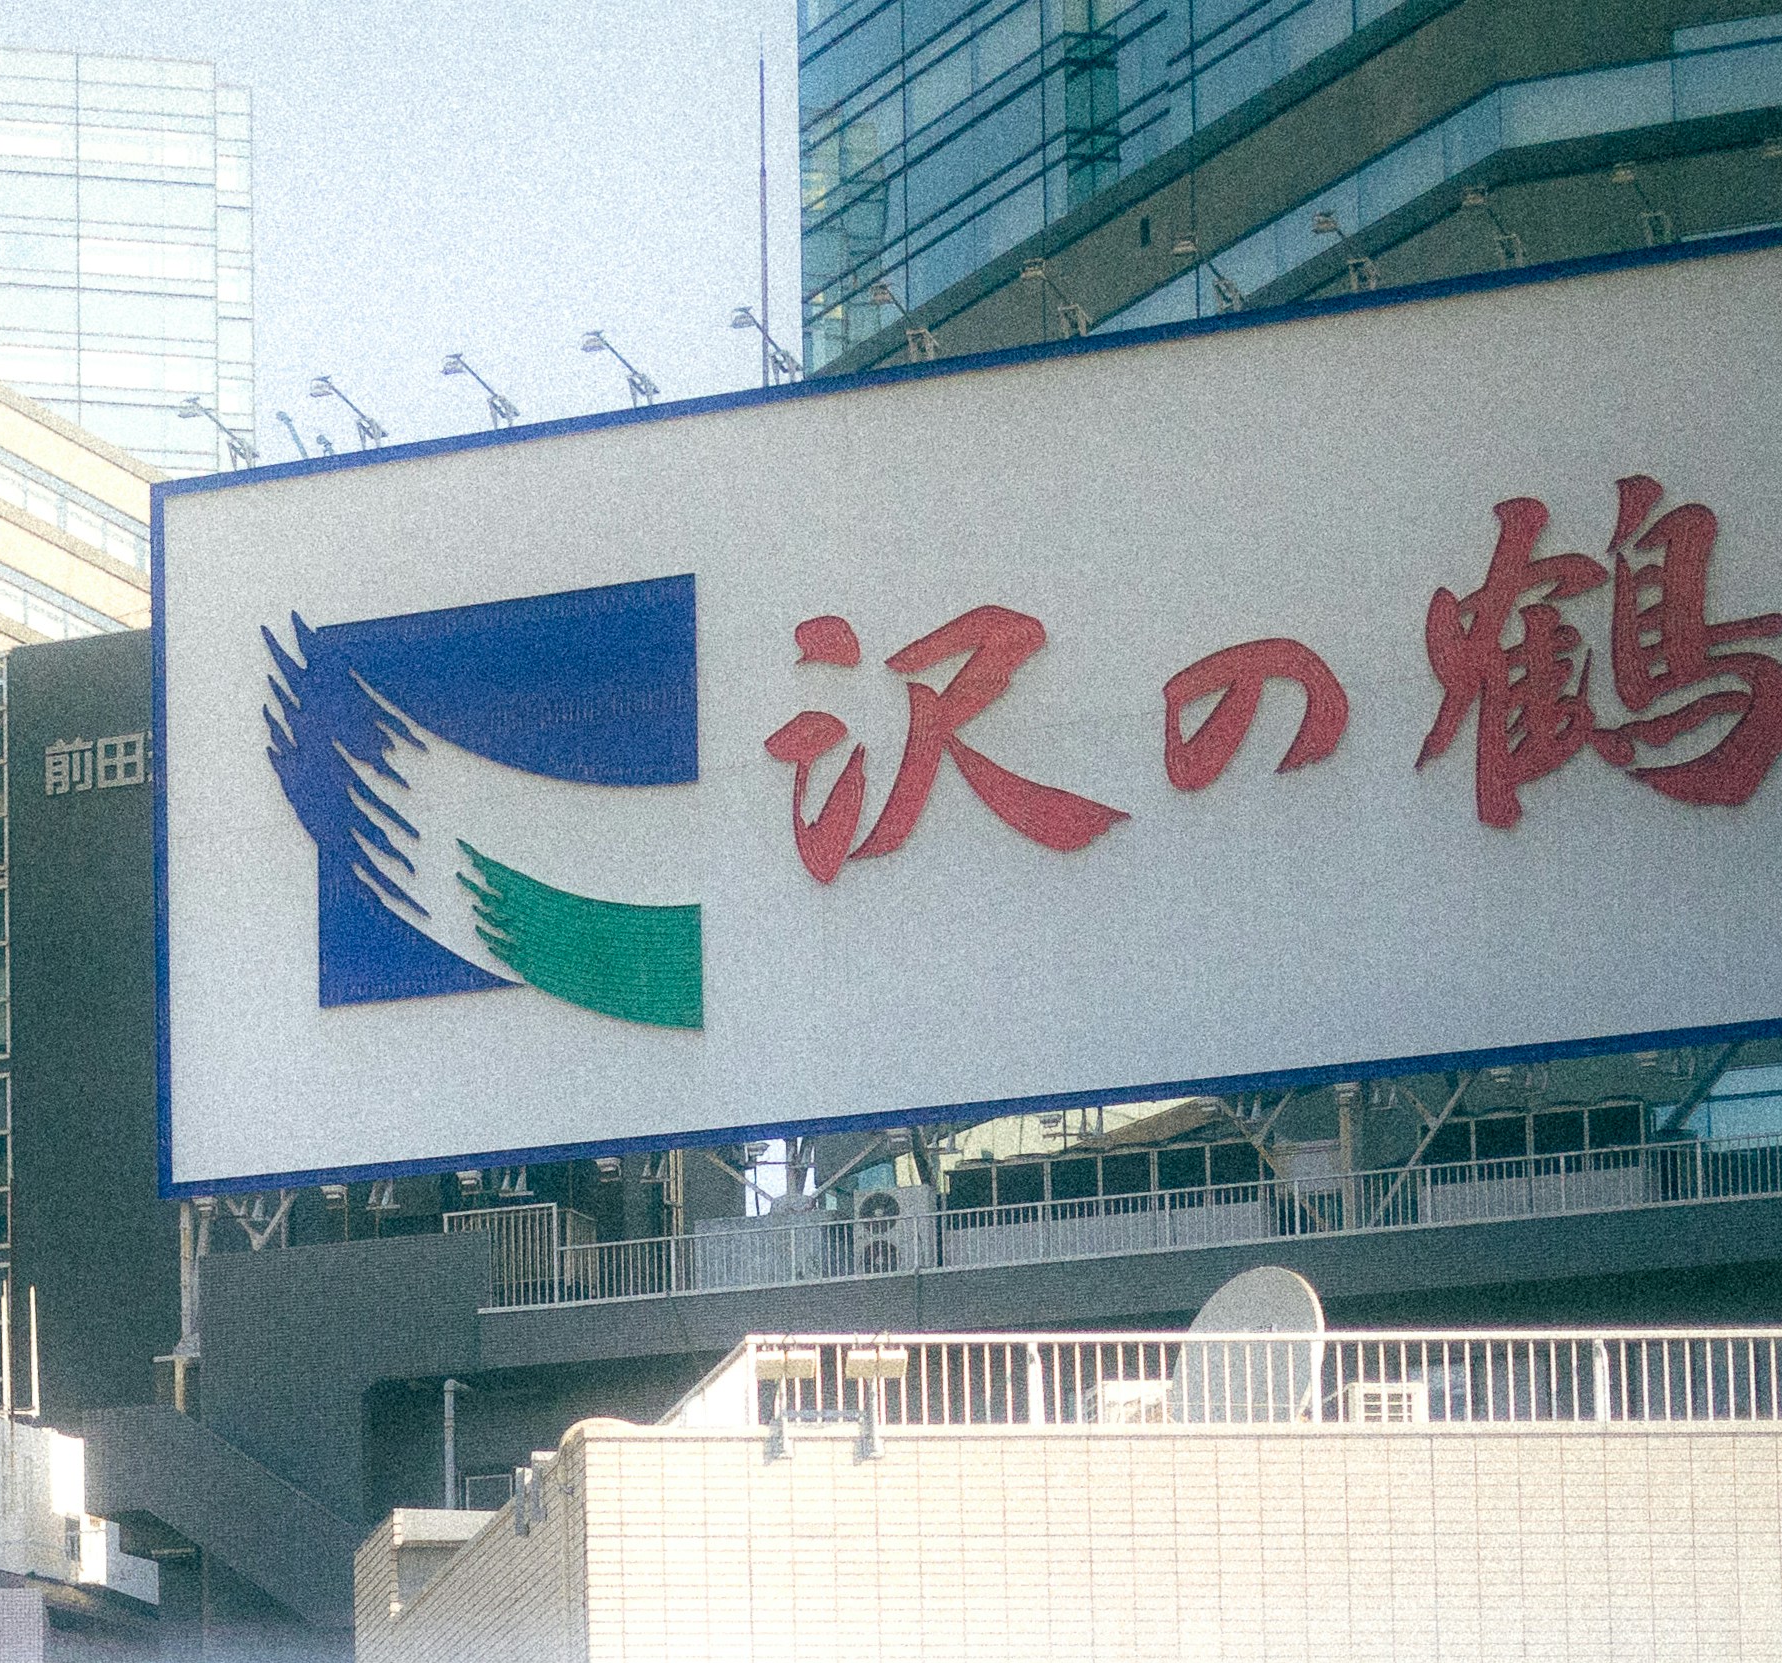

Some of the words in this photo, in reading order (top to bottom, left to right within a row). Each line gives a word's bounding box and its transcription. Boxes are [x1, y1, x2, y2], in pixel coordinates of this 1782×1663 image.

[44, 730, 153, 796] 前田
[764, 474, 1782, 886] 沢の鶴
